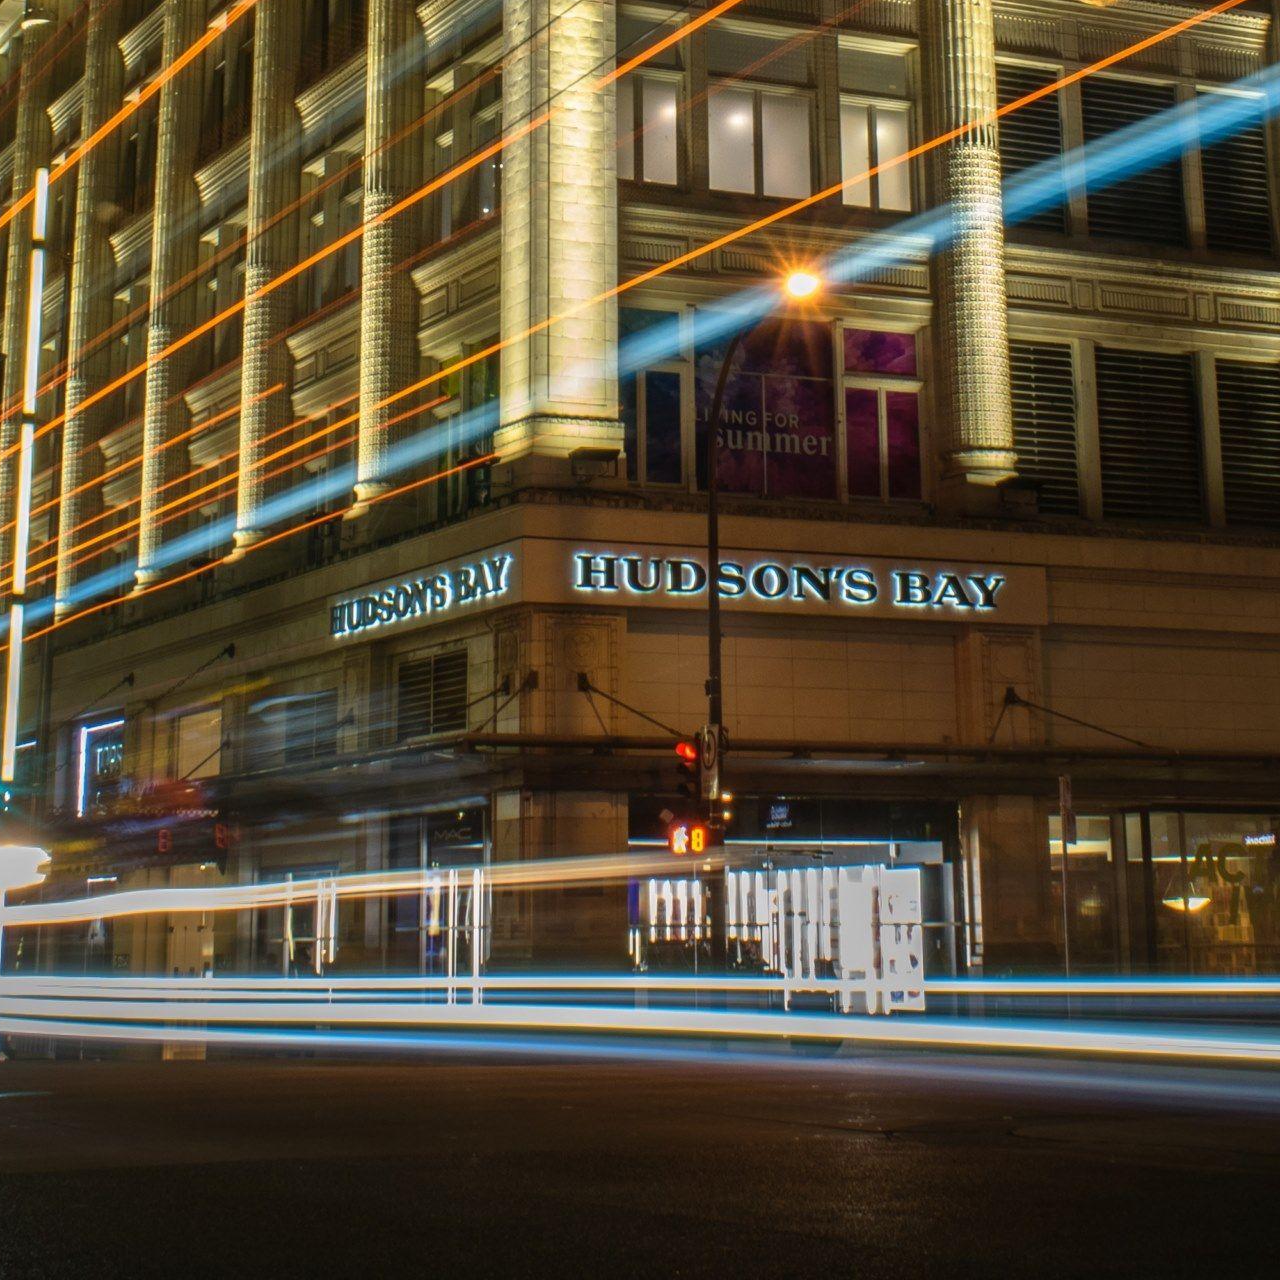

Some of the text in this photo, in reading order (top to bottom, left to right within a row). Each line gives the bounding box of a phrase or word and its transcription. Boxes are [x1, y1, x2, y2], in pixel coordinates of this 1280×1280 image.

[765, 412, 800, 429] FOR
[715, 428, 833, 457] summer
[329, 554, 511, 637] HUDSON'S BAY
[575, 553, 1006, 609] HUDSON'S BAY
